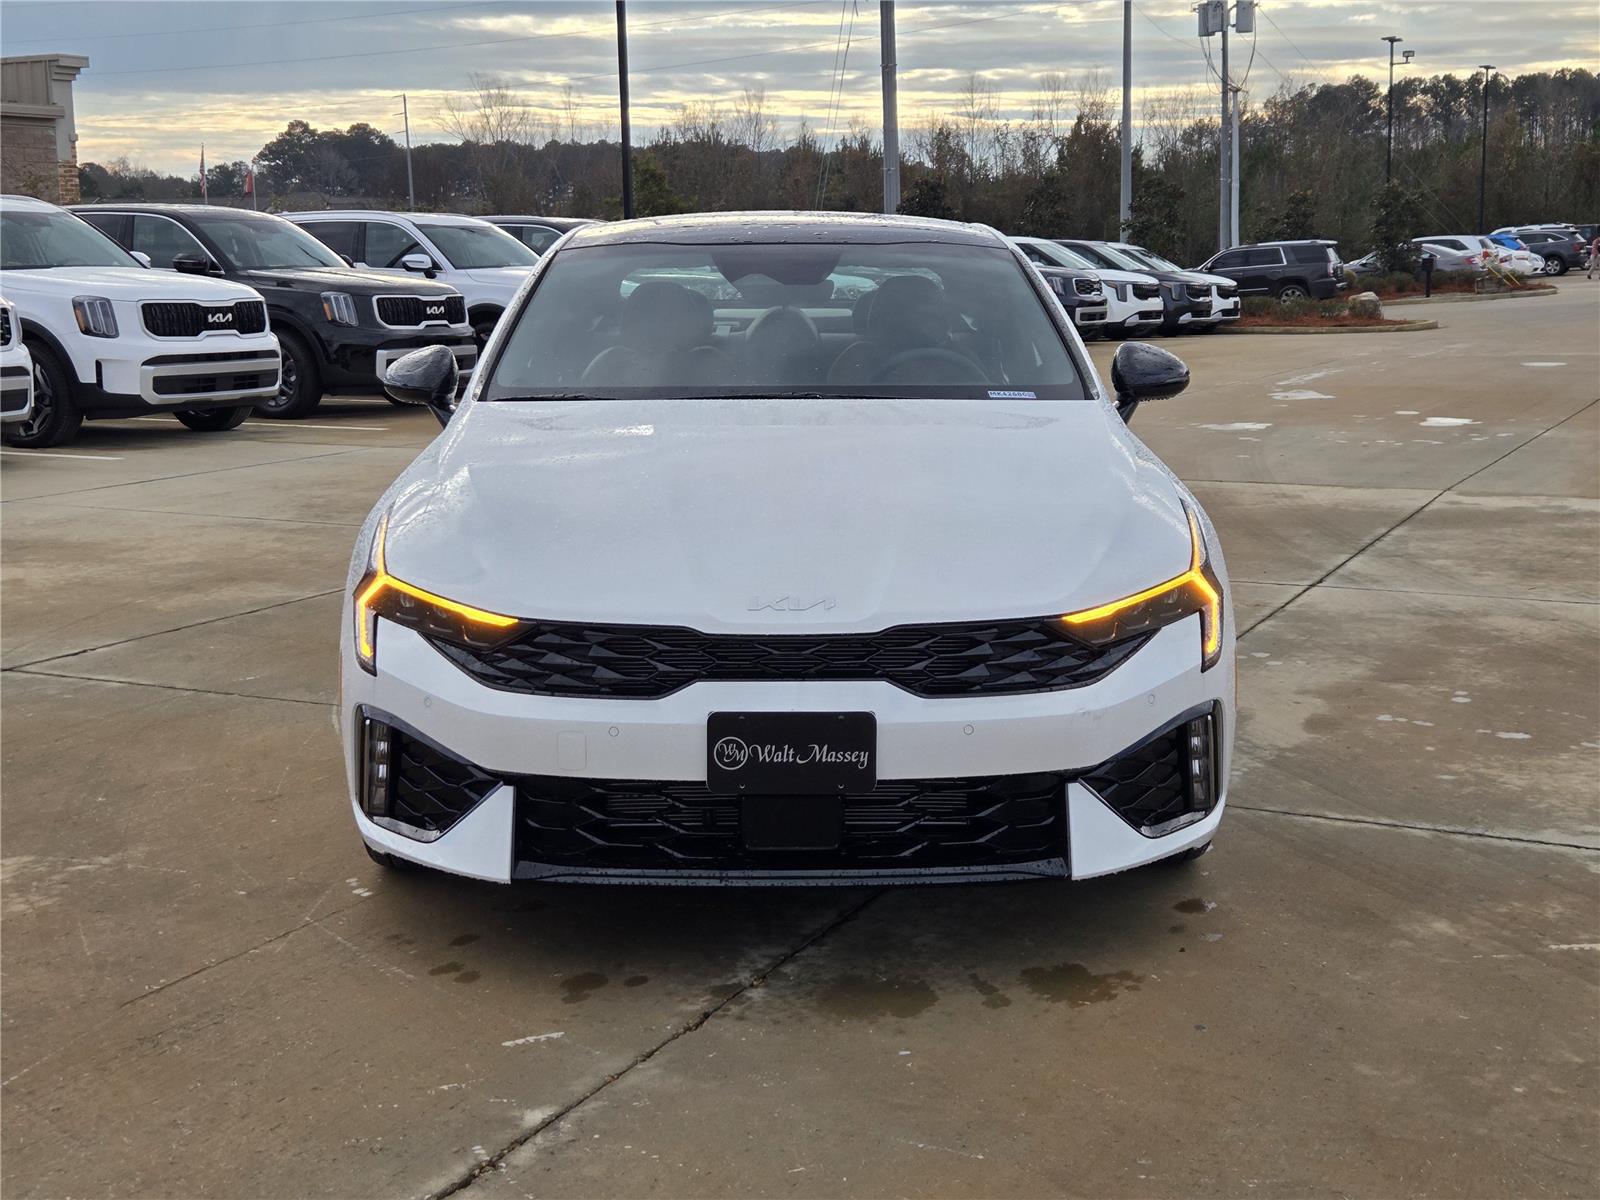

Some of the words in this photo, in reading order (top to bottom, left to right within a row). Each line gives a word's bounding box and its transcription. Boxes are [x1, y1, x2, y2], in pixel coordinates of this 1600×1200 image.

[426, 306, 445, 315] KIA
[208, 313, 232, 323] KIA
[746, 595, 837, 611] KIA
[749, 744, 795, 763] Walt
[796, 744, 869, 769] Massey
